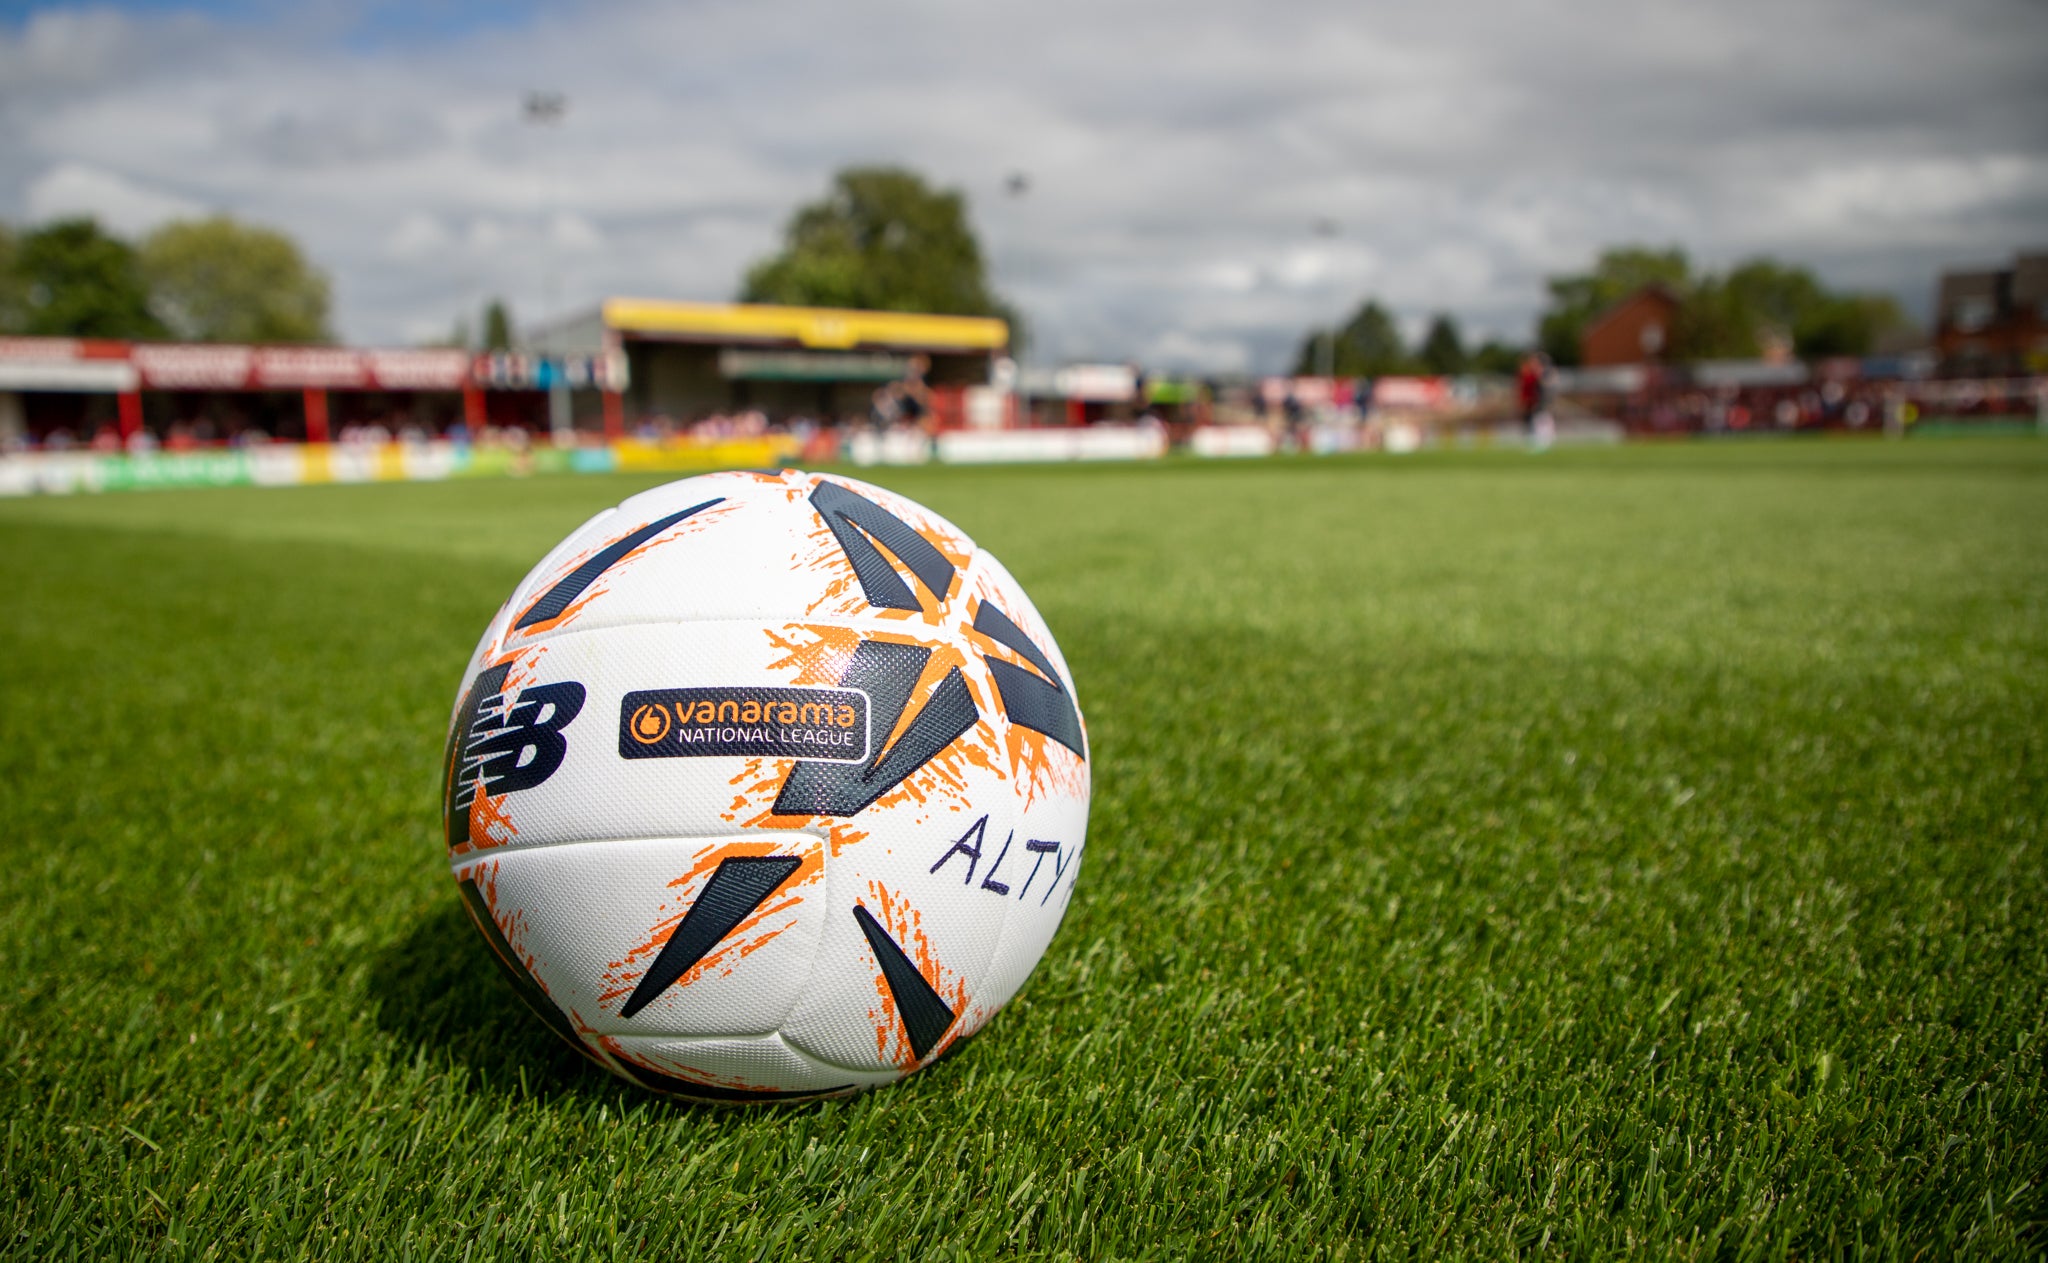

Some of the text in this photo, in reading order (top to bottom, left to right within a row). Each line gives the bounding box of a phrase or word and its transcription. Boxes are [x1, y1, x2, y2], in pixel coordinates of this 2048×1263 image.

[675, 700, 855, 727] vanarama
[679, 728, 854, 746] NATIONAL LEAGUE
[930, 814, 1075, 907] ALTY
